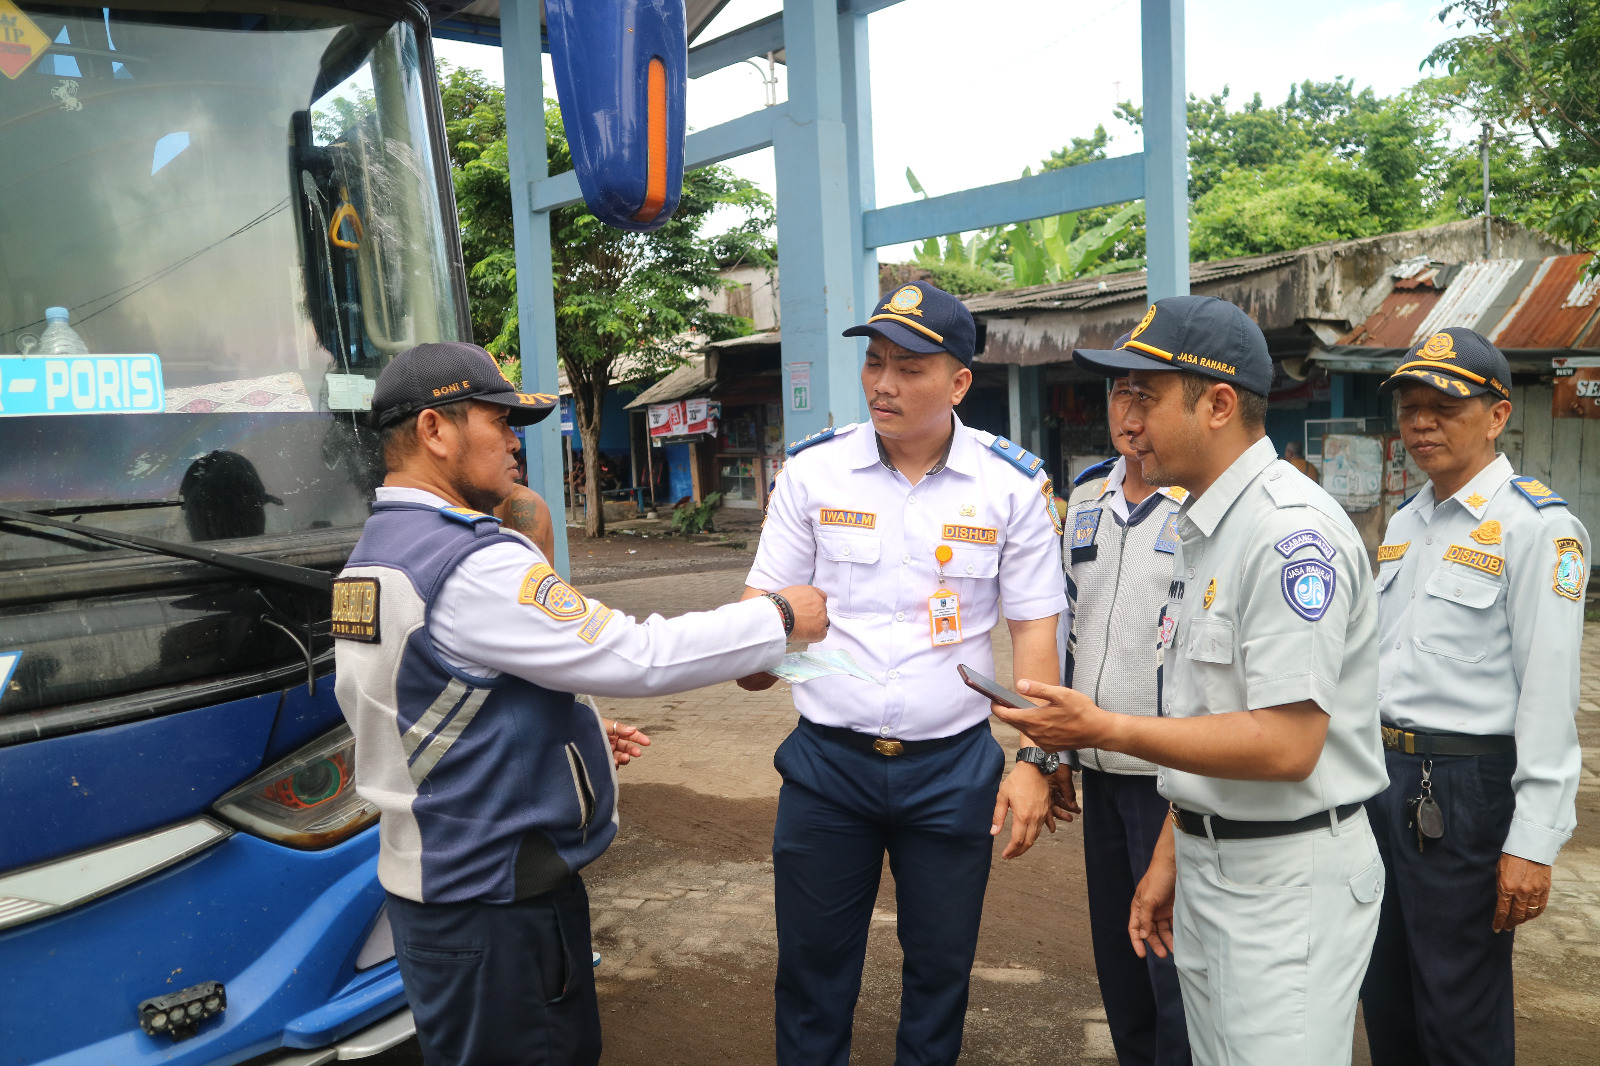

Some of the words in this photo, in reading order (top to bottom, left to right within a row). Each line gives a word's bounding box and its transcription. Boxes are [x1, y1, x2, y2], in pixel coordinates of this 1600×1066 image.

[1177, 352, 1198, 365] JASA
[1199, 357, 1236, 376] RAHARJA
[1556, 368, 1574, 376] NEW
[45, 359, 154, 410] PORIS
[432, 383, 460, 397] BONI
[461, 380, 471, 389] E
[822, 510, 873, 526] IWAN.M
[945, 526, 995, 541] DISHUB
[1283, 534, 1314, 551] CABANG
[1450, 547, 1500, 571] DISHUB
[1287, 567, 1305, 579] JASA
